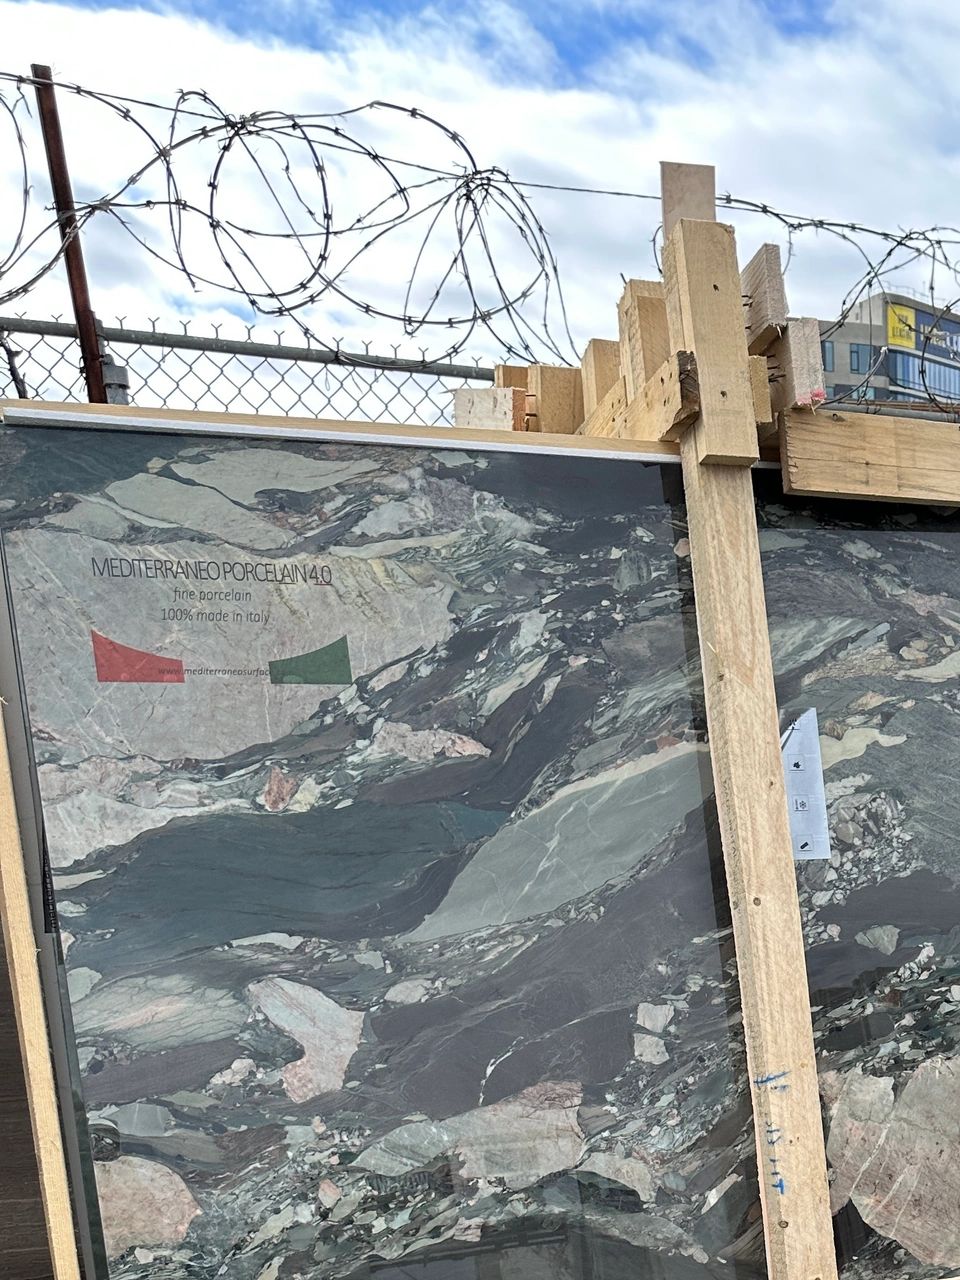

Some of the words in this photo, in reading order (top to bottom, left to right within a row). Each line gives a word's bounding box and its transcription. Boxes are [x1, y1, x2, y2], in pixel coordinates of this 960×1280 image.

[91, 557, 221, 581] MEDITERRANEO
[223, 561, 308, 583] PORCELAIN
[309, 564, 332, 584] 4.0
[173, 587, 196, 602] fine
[199, 587, 252, 602] porcelain
[161, 608, 194, 621] 100%
[196, 608, 229, 622] made
[232, 611, 243, 622] in
[246, 610, 270, 626] italy
